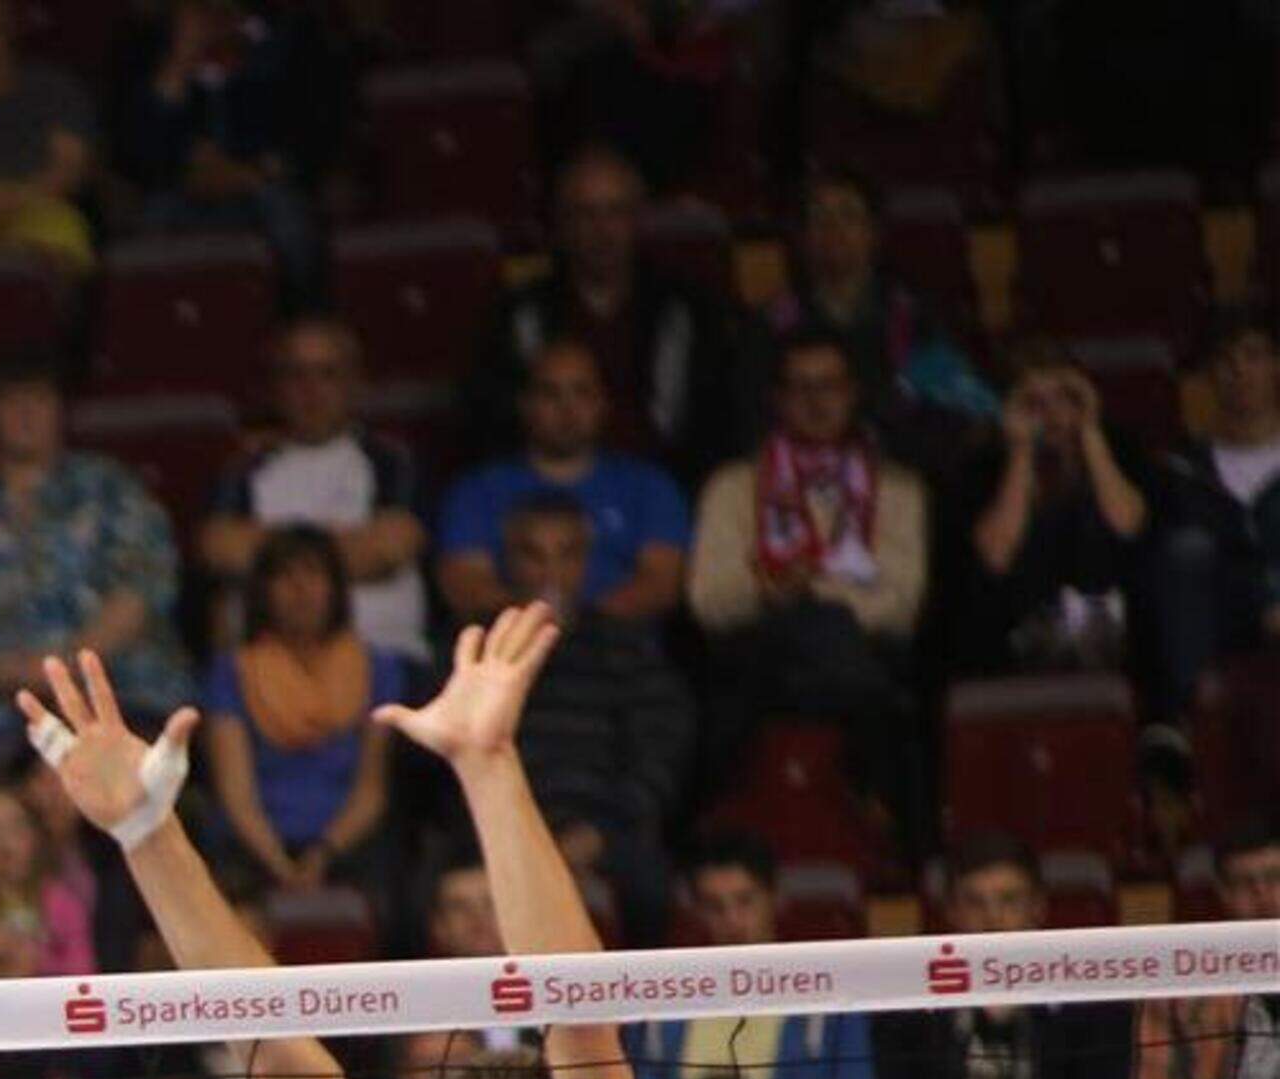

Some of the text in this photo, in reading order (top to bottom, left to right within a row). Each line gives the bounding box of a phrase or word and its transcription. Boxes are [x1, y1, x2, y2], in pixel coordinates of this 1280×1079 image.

[543, 966, 833, 1006] Sparkasse Düren
[982, 948, 1278, 988] Sparkasse Düren
[116, 985, 399, 1025] Sparkasse Düren
